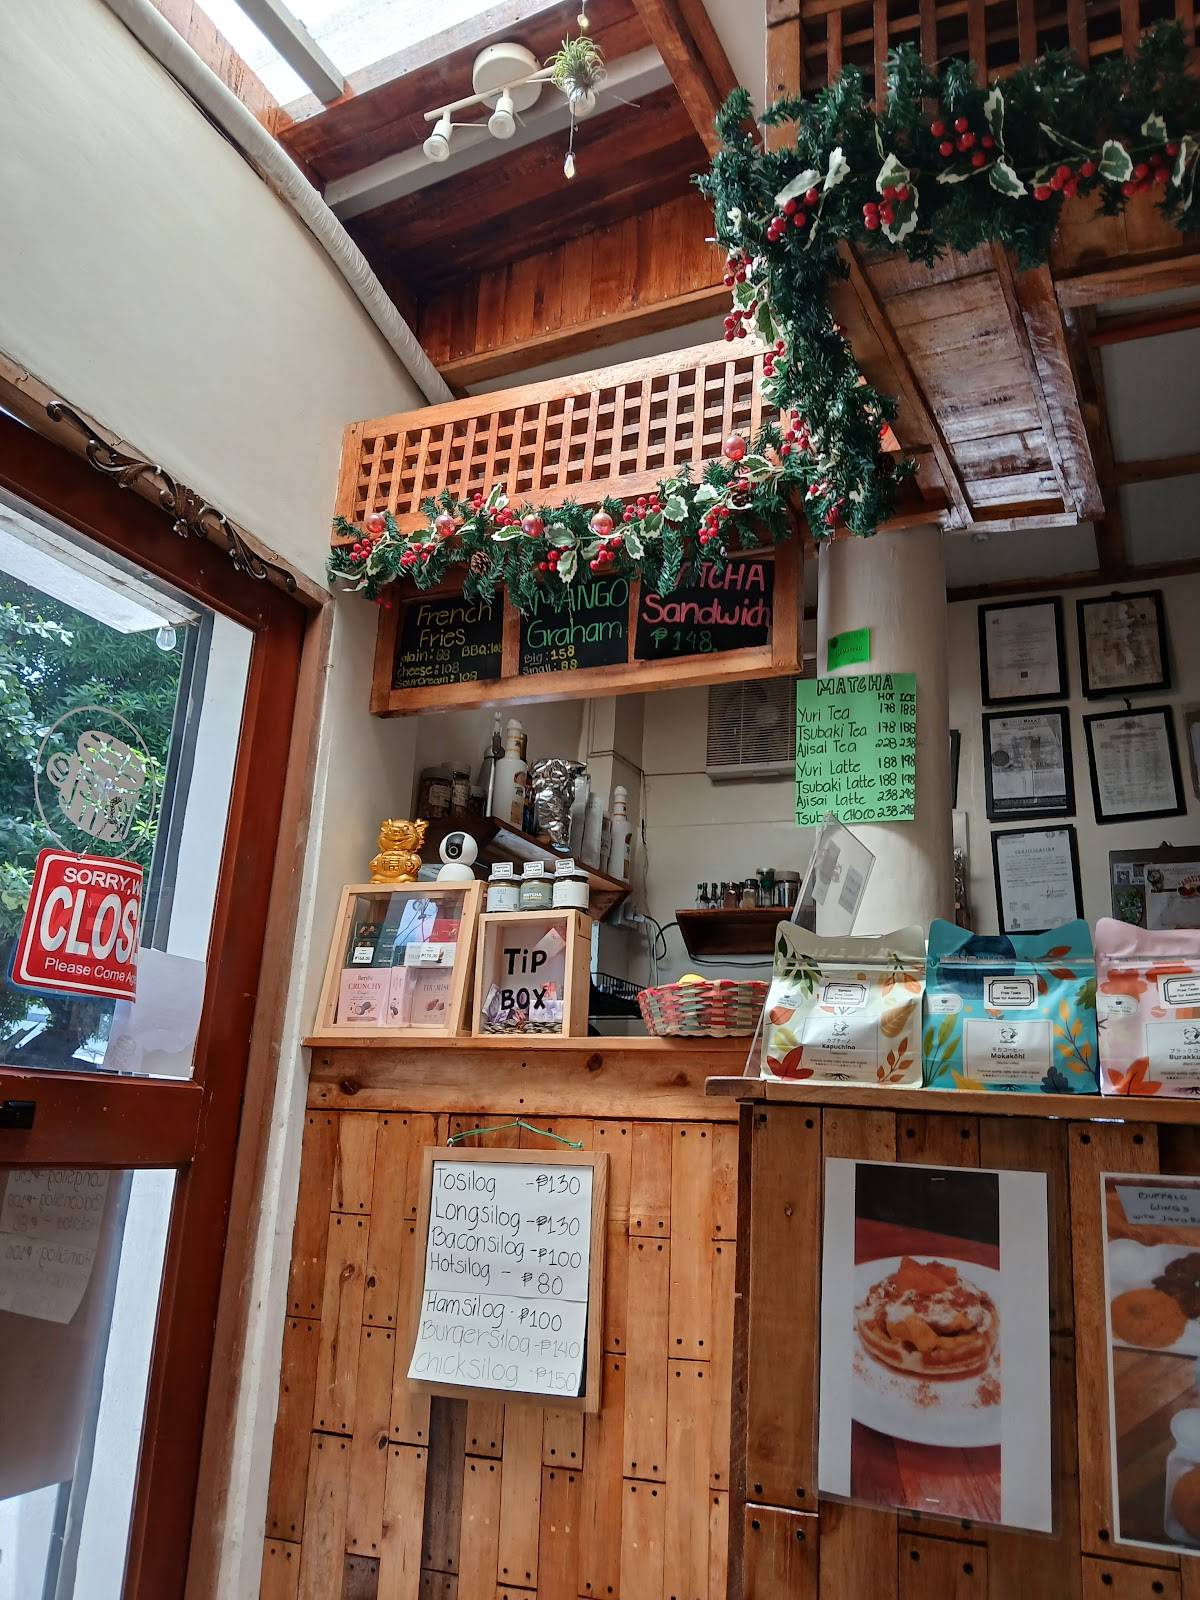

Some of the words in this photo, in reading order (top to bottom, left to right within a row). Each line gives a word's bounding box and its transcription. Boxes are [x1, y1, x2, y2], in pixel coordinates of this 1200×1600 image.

[416, 600, 492, 626] French
[419, 628, 466, 648] Fries
[527, 619, 622, 648] Graham
[816, 675, 894, 697] MATCHA
[877, 692, 895, 701] HOT
[797, 706, 821, 724] Yuri
[828, 705, 850, 721] Tea
[879, 702, 896, 714] 178
[900, 703, 916, 716] 188
[796, 723, 845, 741] Tsubaki
[848, 721, 867, 737] Tea
[878, 720, 897, 733] 178
[833, 739, 857, 753] Tea
[875, 737, 897, 749] 228
[899, 736, 916, 748] 238
[797, 761, 822, 778] Yuri
[829, 759, 861, 775] Latte
[878, 756, 898, 768] 188
[795, 777, 841, 795] Tsubaki
[846, 774, 876, 789] Latte
[879, 772, 897, 786] 188
[796, 794, 828, 812] Ajisai
[835, 791, 867, 806] Latte
[877, 788, 898, 801] 238
[795, 810, 839, 825] Tsubi
[842, 808, 875, 821] CHOCO
[877, 805, 898, 817] 238
[63, 867, 131, 896] SORRY,
[44, 957, 91, 975] Please
[94, 965, 126, 982] Come
[501, 987, 547, 1011] BOX
[435, 1167, 497, 1201] Tosilog
[434, 1196, 521, 1237] Longsilog
[431, 1225, 526, 1263] Baconsilog
[429, 1252, 491, 1287] Hotsilog
[424, 1290, 505, 1329] Hamsilog
